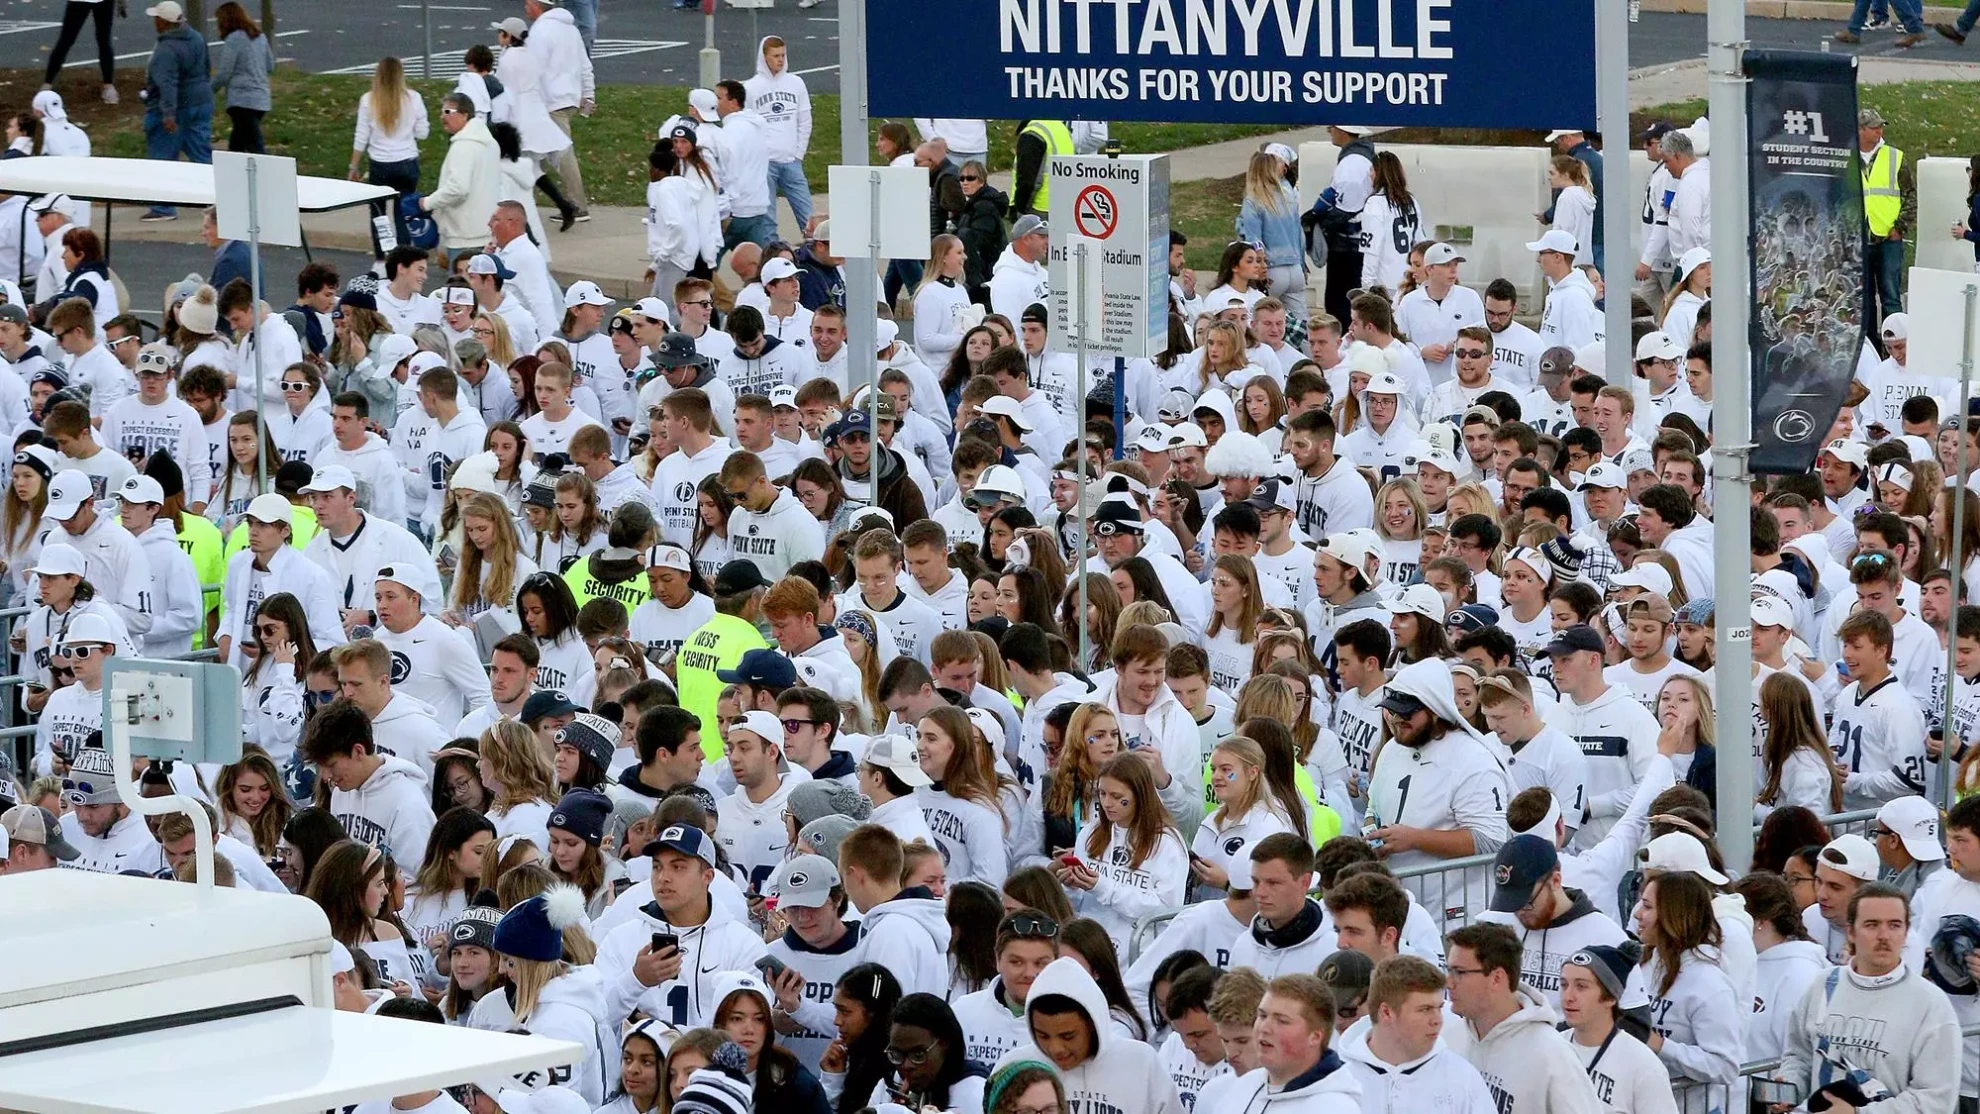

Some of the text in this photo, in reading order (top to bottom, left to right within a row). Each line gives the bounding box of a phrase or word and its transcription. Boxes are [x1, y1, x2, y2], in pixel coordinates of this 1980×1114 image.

[1000, 0, 1453, 58] NITTANYVILLE
[1005, 67, 1448, 106] THANKS FOR YOUR SUPPORT
[1784, 110, 1829, 143] #1
[1762, 143, 1851, 157] STUDENT SECTION
[1767, 156, 1848, 168] IN THE COUNTRY
[1052, 161, 1139, 185] No Smoking
[1360, 231, 1373, 248] 62
[1051, 246, 1060, 261] In
[580, 292, 586, 301] S
[1112, 301, 1126, 309] inside
[1124, 321, 1133, 329] may
[1494, 346, 1525, 368] STATE
[727, 371, 784, 388] EXPECT EXCESSIVE
[775, 388, 792, 397] PSU
[751, 537, 776, 555] STATE
[138, 590, 152, 614] 11
[584, 580, 646, 605] SECURITY
[52, 722, 74, 734] EXPECT
[580, 714, 611, 734] STATE
[1905, 755, 1926, 781] 21
[1395, 774, 1412, 824] 1
[1492, 787, 1502, 811] 1
[1574, 784, 1583, 810] 1
[353, 817, 386, 845] STATE
[1928, 824, 1934, 836] S
[1113, 869, 1148, 890] STATE
[467, 908, 503, 924] STATE
[667, 985, 688, 1027] 1
[968, 1046, 1003, 1061] EXPECT
